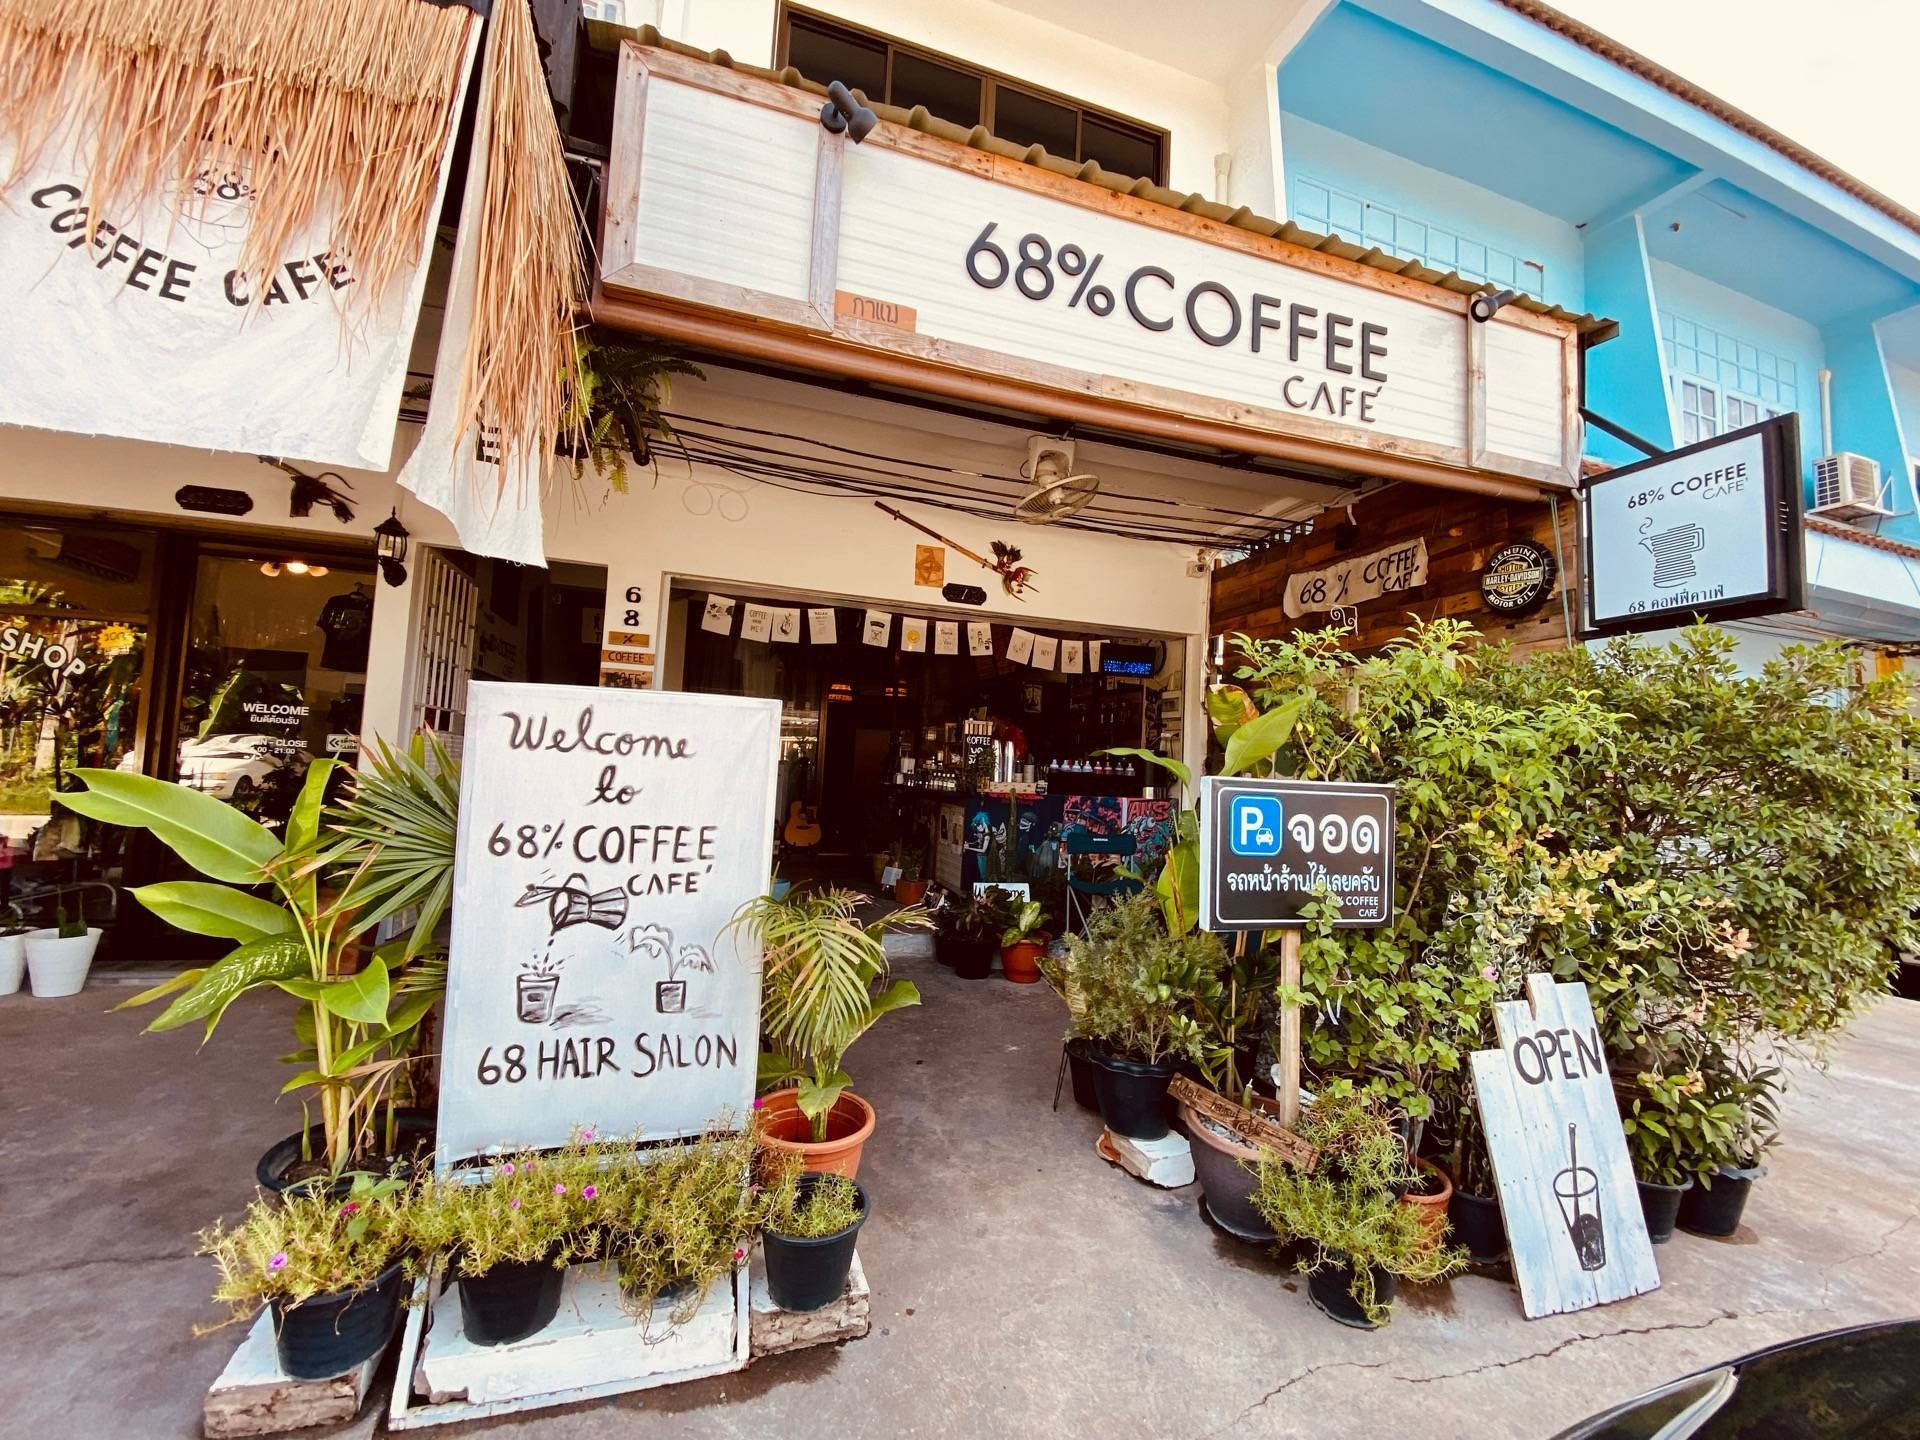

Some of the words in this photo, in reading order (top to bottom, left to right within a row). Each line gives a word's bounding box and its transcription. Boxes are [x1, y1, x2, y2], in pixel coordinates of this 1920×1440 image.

[31, 184, 197, 302] COFFEE
[1627, 487, 1664, 509] 68%
[1671, 463, 1747, 496] COFFEE
[1491, 547, 1537, 567] GENUINE
[1485, 569, 1540, 585] HARLEY-DAVIDSON
[1488, 594, 1514, 608] MOTOR
[1517, 590, 1535, 605] OIL
[1629, 601, 1646, 614] 68
[0, 628, 86, 677] SHOP
[608, 650, 646, 664] COFFEE
[243, 702, 309, 716] WELCOME
[276, 738, 308, 748] CLOSE
[500, 706, 696, 760] Welcome
[966, 735, 992, 746] COFFEE
[586, 764, 645, 806] to
[487, 820, 566, 859] 68%
[573, 824, 719, 865] COFFEE
[1287, 813, 1380, 854] จอด
[1345, 896, 1379, 906] COFFEE
[477, 1043, 526, 1085] 68
[538, 1036, 622, 1081] HAIR
[632, 1031, 738, 1078] SALON
[1513, 1027, 1603, 1085] OPEN
